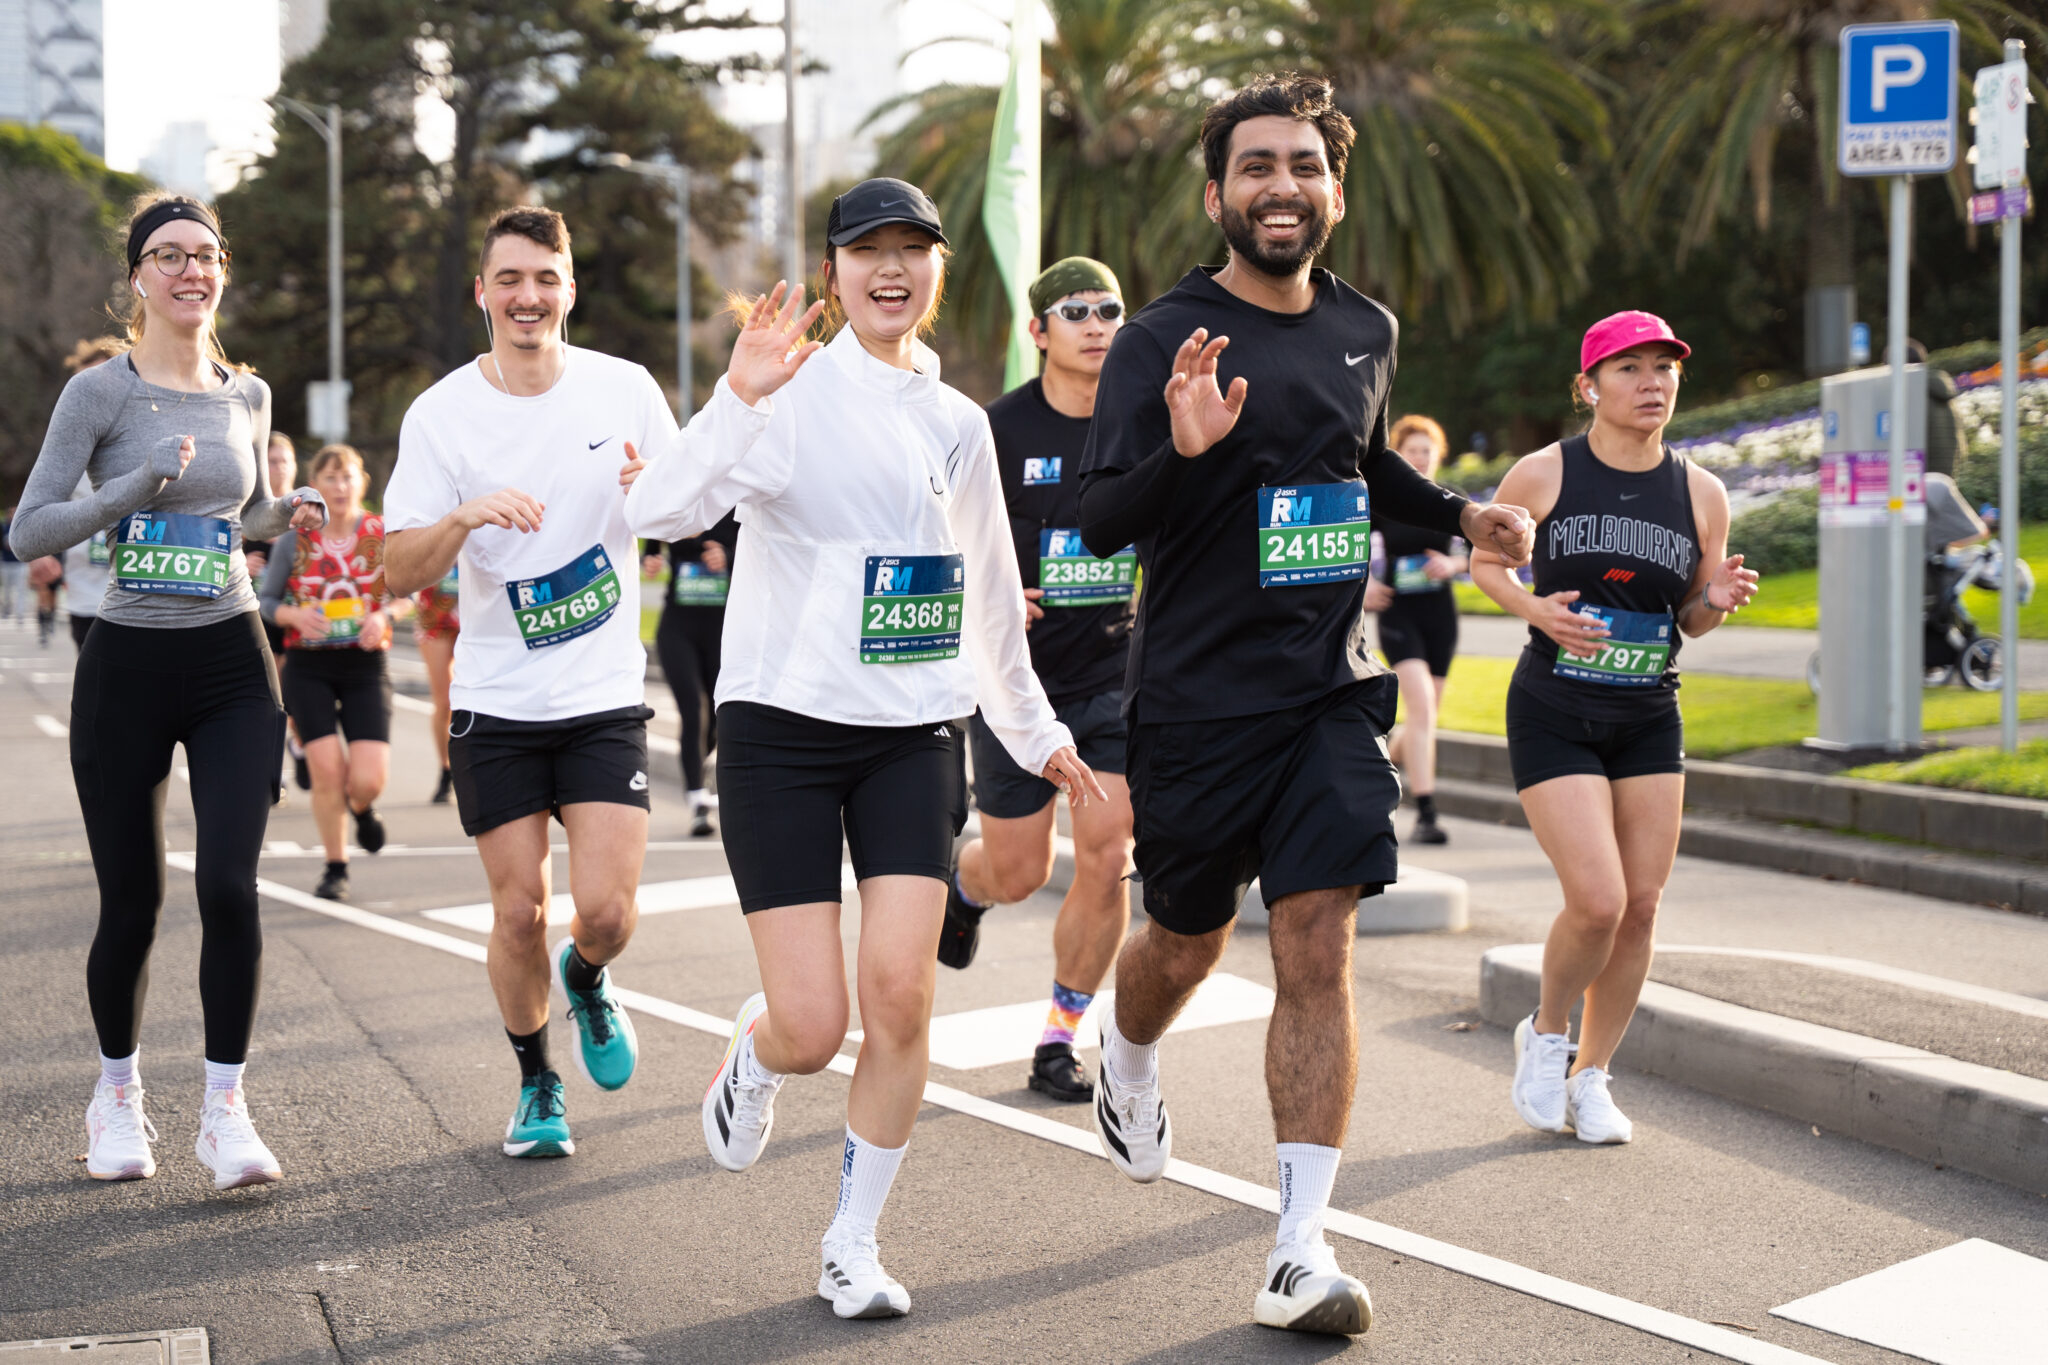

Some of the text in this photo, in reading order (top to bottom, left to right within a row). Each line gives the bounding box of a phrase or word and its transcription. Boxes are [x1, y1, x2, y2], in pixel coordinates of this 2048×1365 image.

[1871, 44, 1926, 112] P
[1847, 143, 1904, 162] AREA
[1024, 456, 1062, 480] RM
[1270, 496, 1312, 522] RM
[127, 519, 167, 541] RM
[1353, 533, 1366, 543] 10K
[1049, 535, 1082, 554] RM
[1266, 531, 1349, 562] 24155
[1549, 514, 1692, 581] MELBOURNE
[122, 550, 207, 576] 24767
[212, 561, 226, 571] 10K
[1044, 561, 1114, 583] 23852
[601, 580, 616, 593] 10K
[874, 566, 913, 591] RM
[518, 582, 552, 606] RM
[522, 591, 600, 633] 24768
[867, 601, 943, 630] 24368
[947, 603, 959, 613] 10K
[1649, 653, 1663, 661] 10K
